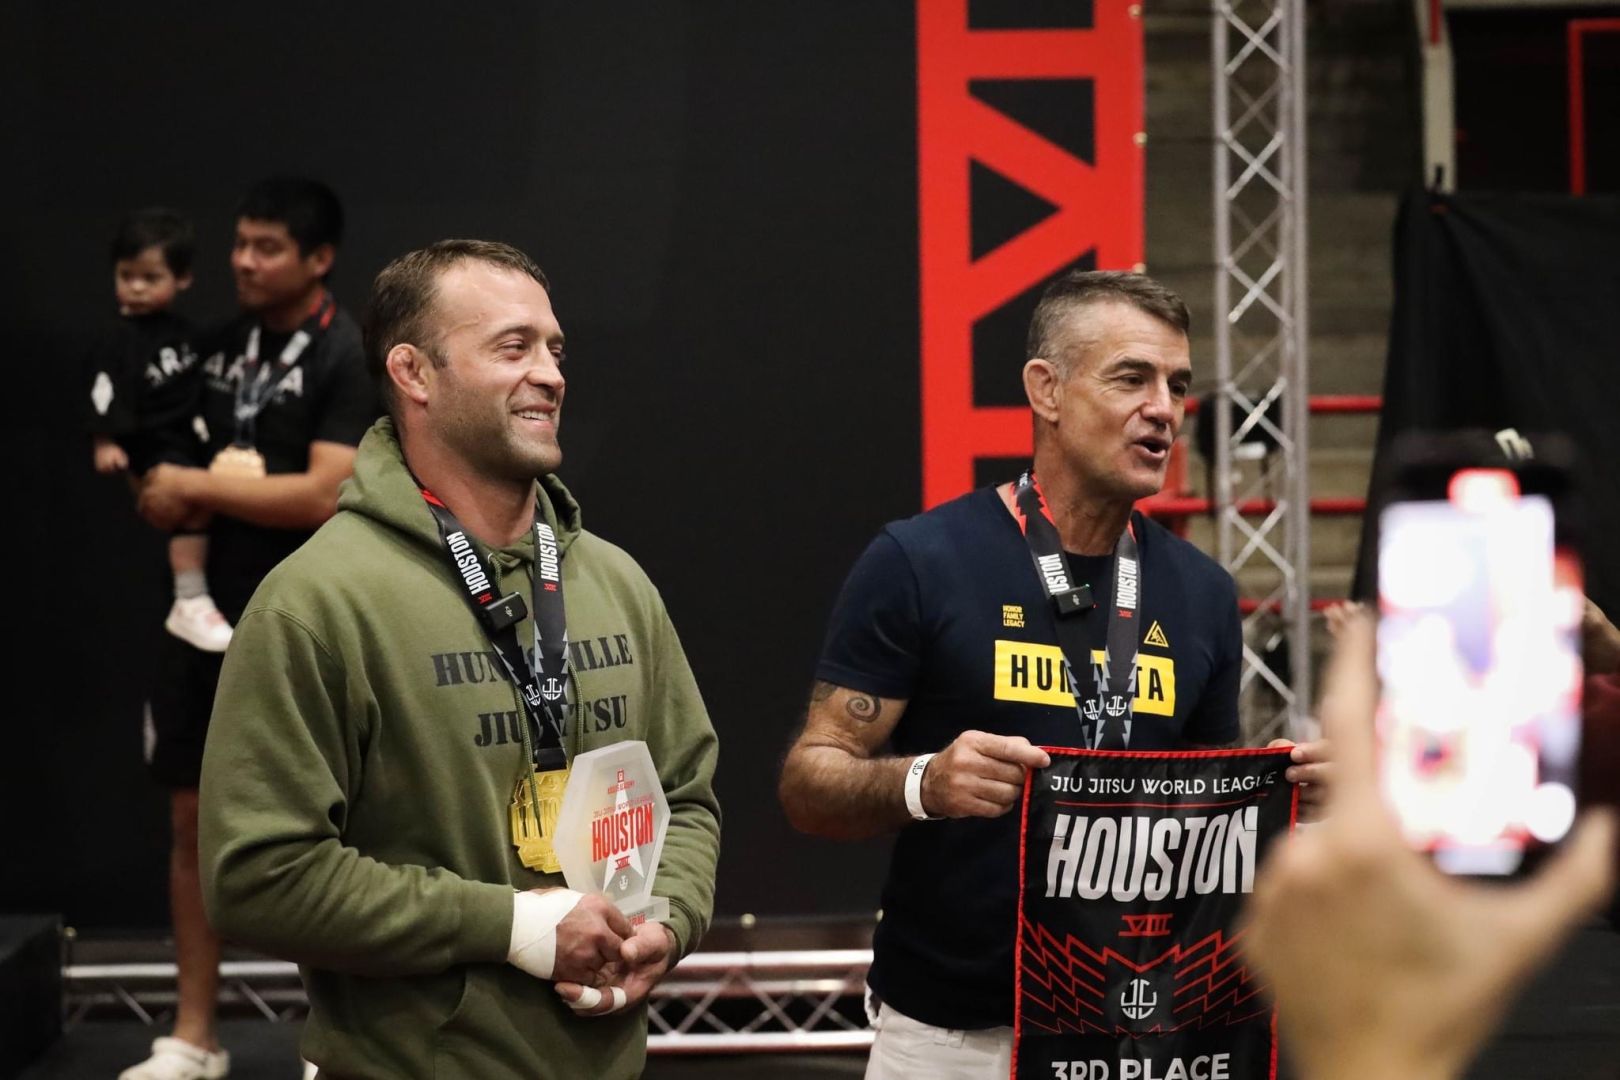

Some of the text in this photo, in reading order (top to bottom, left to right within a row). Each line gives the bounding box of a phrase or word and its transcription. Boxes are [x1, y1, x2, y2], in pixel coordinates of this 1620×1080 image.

[446, 531, 491, 595] HOUSTON
[535, 522, 559, 582] HOUSTON
[1038, 553, 1070, 595] USTON
[1116, 556, 1137, 609] HOUSTON
[431, 634, 633, 687] HUNILLE
[1050, 770, 1275, 796] JIU JITSU WORLD LEAGUE
[592, 803, 654, 863] HOUSTON
[1044, 806, 1259, 902] HOUSTON
[1118, 913, 1173, 937] VIII
[1051, 1053, 1230, 1080] 3RD PLACE
